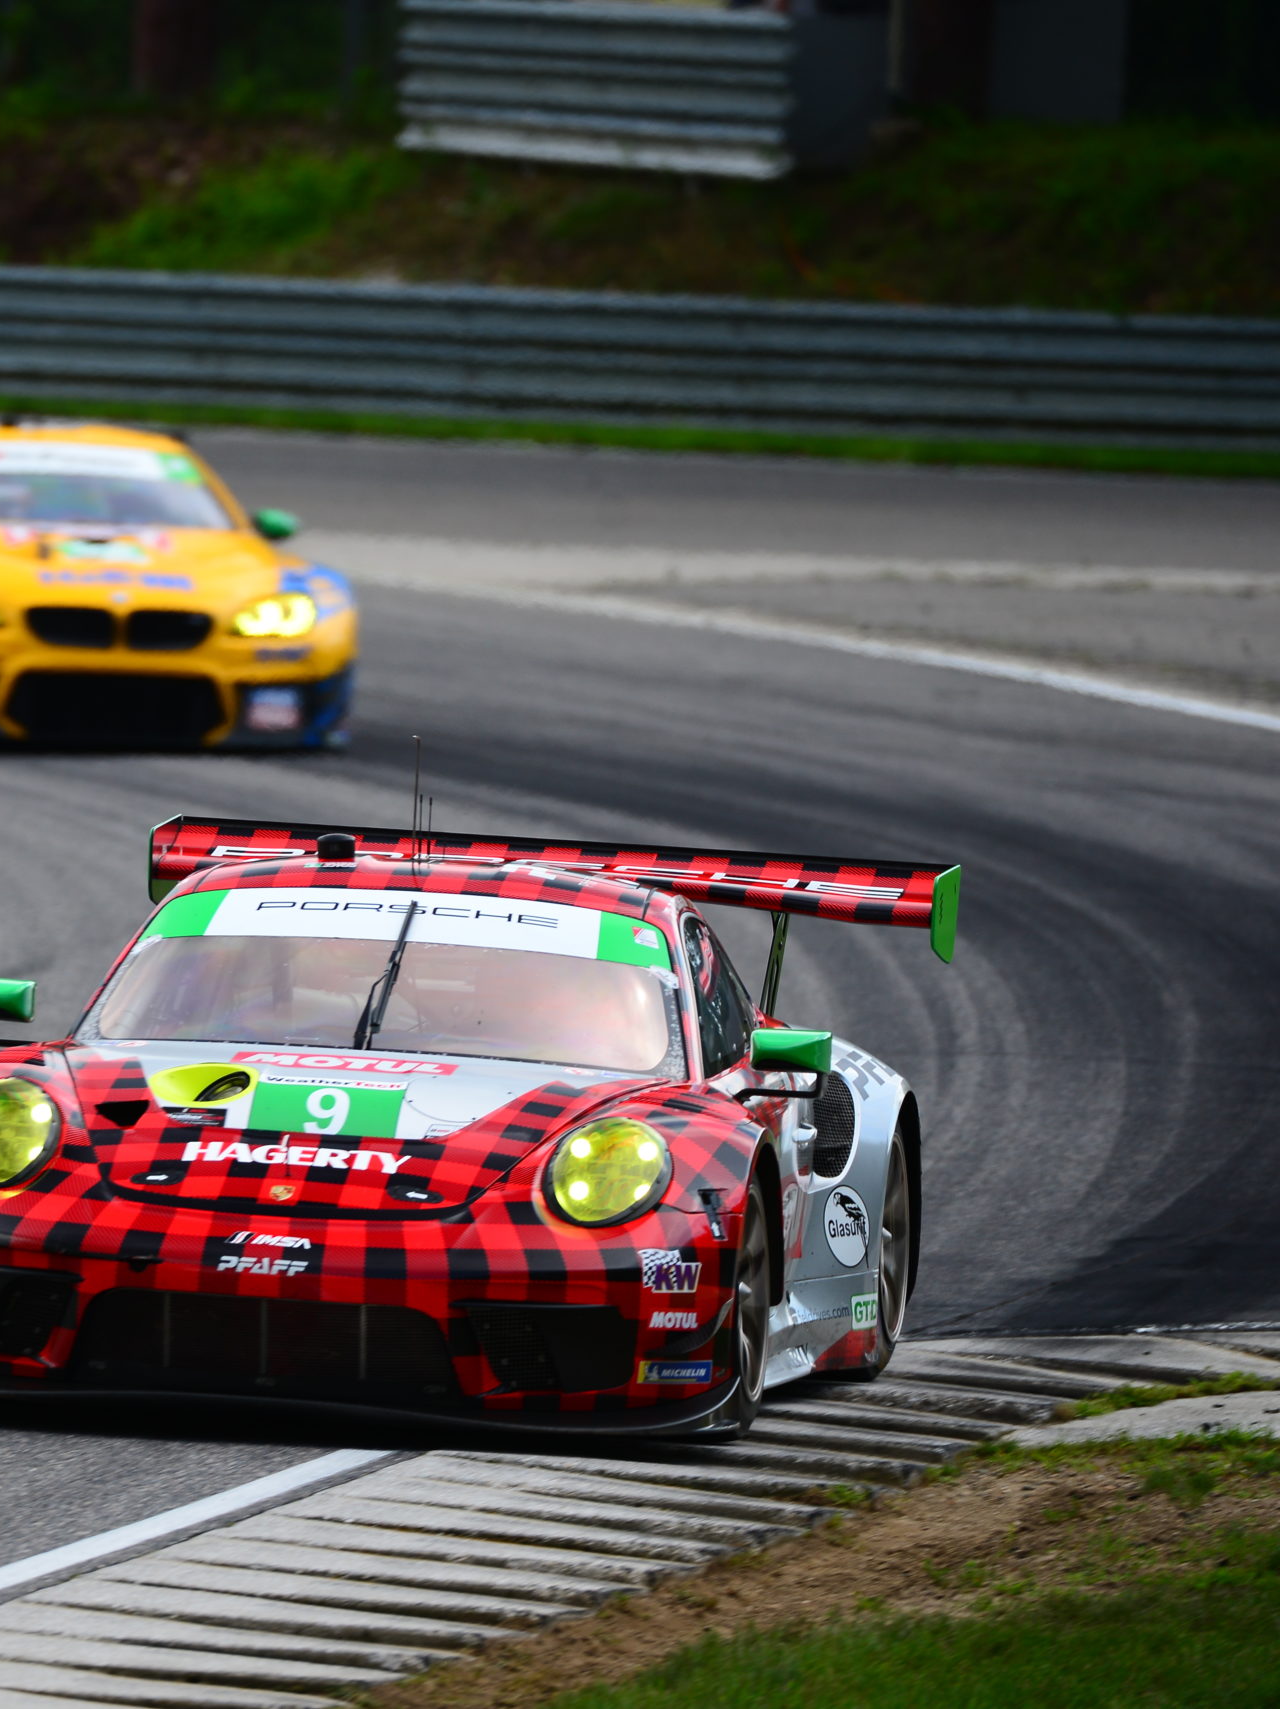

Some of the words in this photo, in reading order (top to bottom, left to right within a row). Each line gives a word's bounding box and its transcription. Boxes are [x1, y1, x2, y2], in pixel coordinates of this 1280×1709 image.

[256, 900, 560, 929] PORSCHE
[240, 1052, 445, 1075] MOTUL
[267, 1075, 402, 1089] WeatherTech
[303, 1087, 351, 1136] 9
[181, 1141, 412, 1175] HAGERTY
[250, 1233, 312, 1250] IMSA
[216, 1255, 309, 1277] PFAFF
[654, 1263, 700, 1291] KW
[648, 1310, 699, 1329] MOTUL
[854, 1299, 878, 1323] GTD
[660, 1366, 707, 1378] MICHELIN
